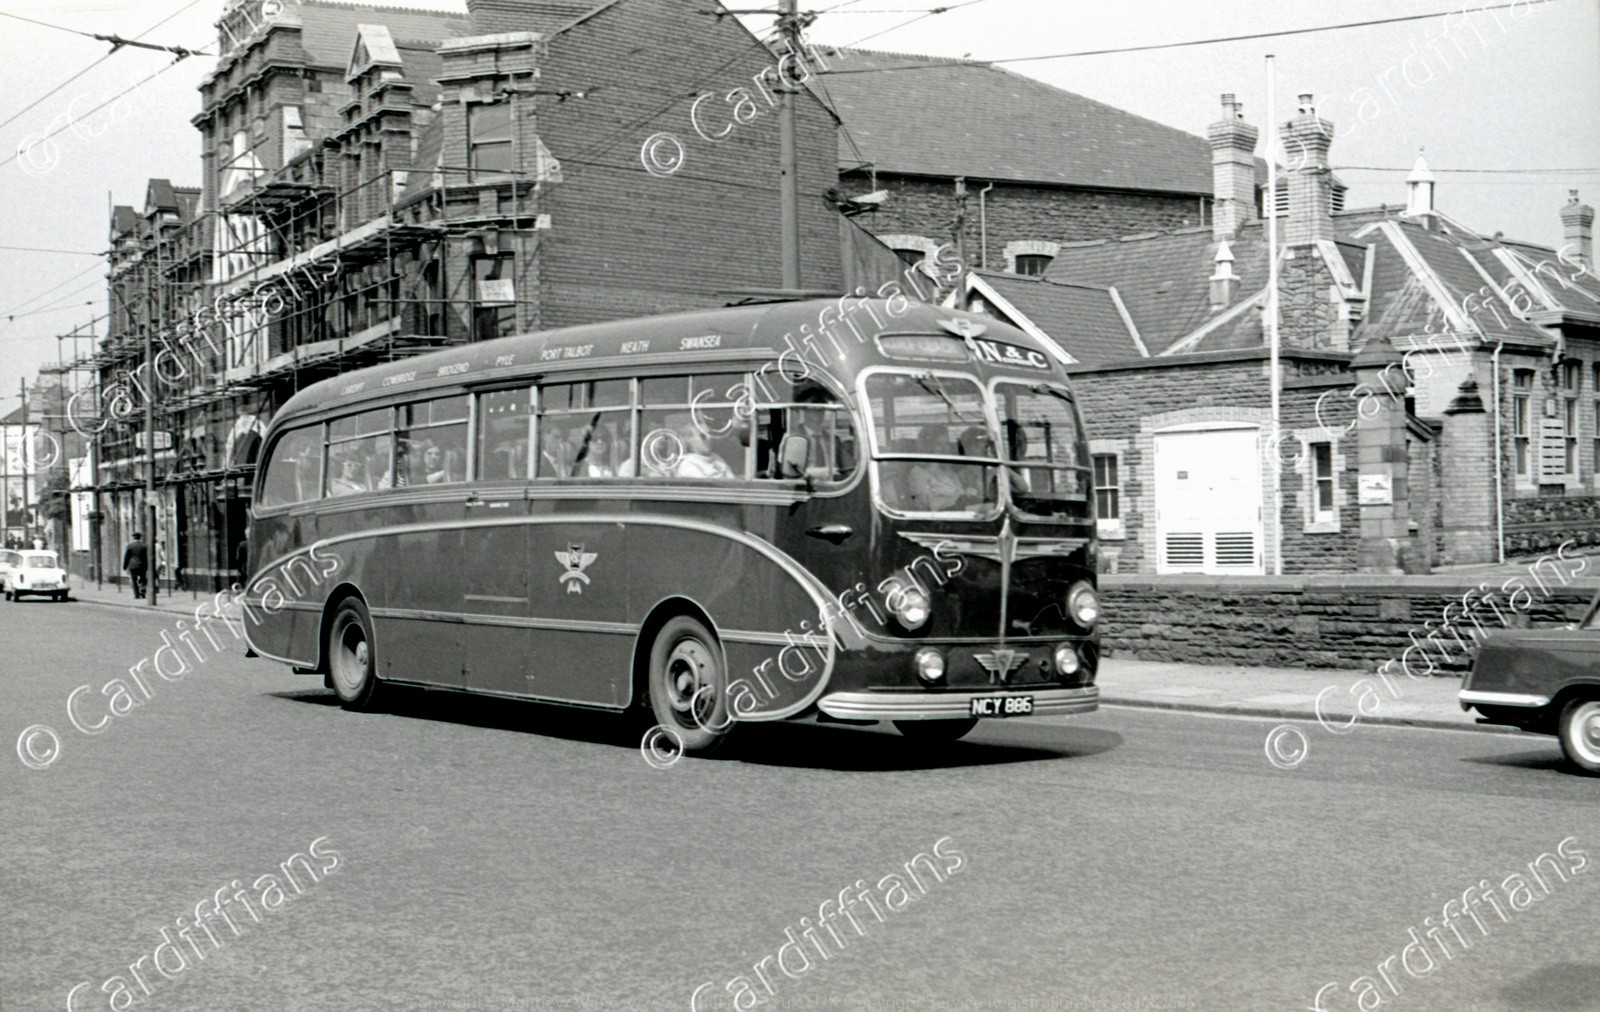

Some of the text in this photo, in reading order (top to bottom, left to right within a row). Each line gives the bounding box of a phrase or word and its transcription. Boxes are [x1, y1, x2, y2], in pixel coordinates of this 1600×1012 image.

[495, 354, 515, 367] PYLE
[540, 347, 563, 361] PORT
[563, 344, 594, 359] TALBOT
[620, 340, 649, 354] NEATH
[679, 335, 721, 350] SWANSEA
[972, 697, 1032, 715] NCY 886
